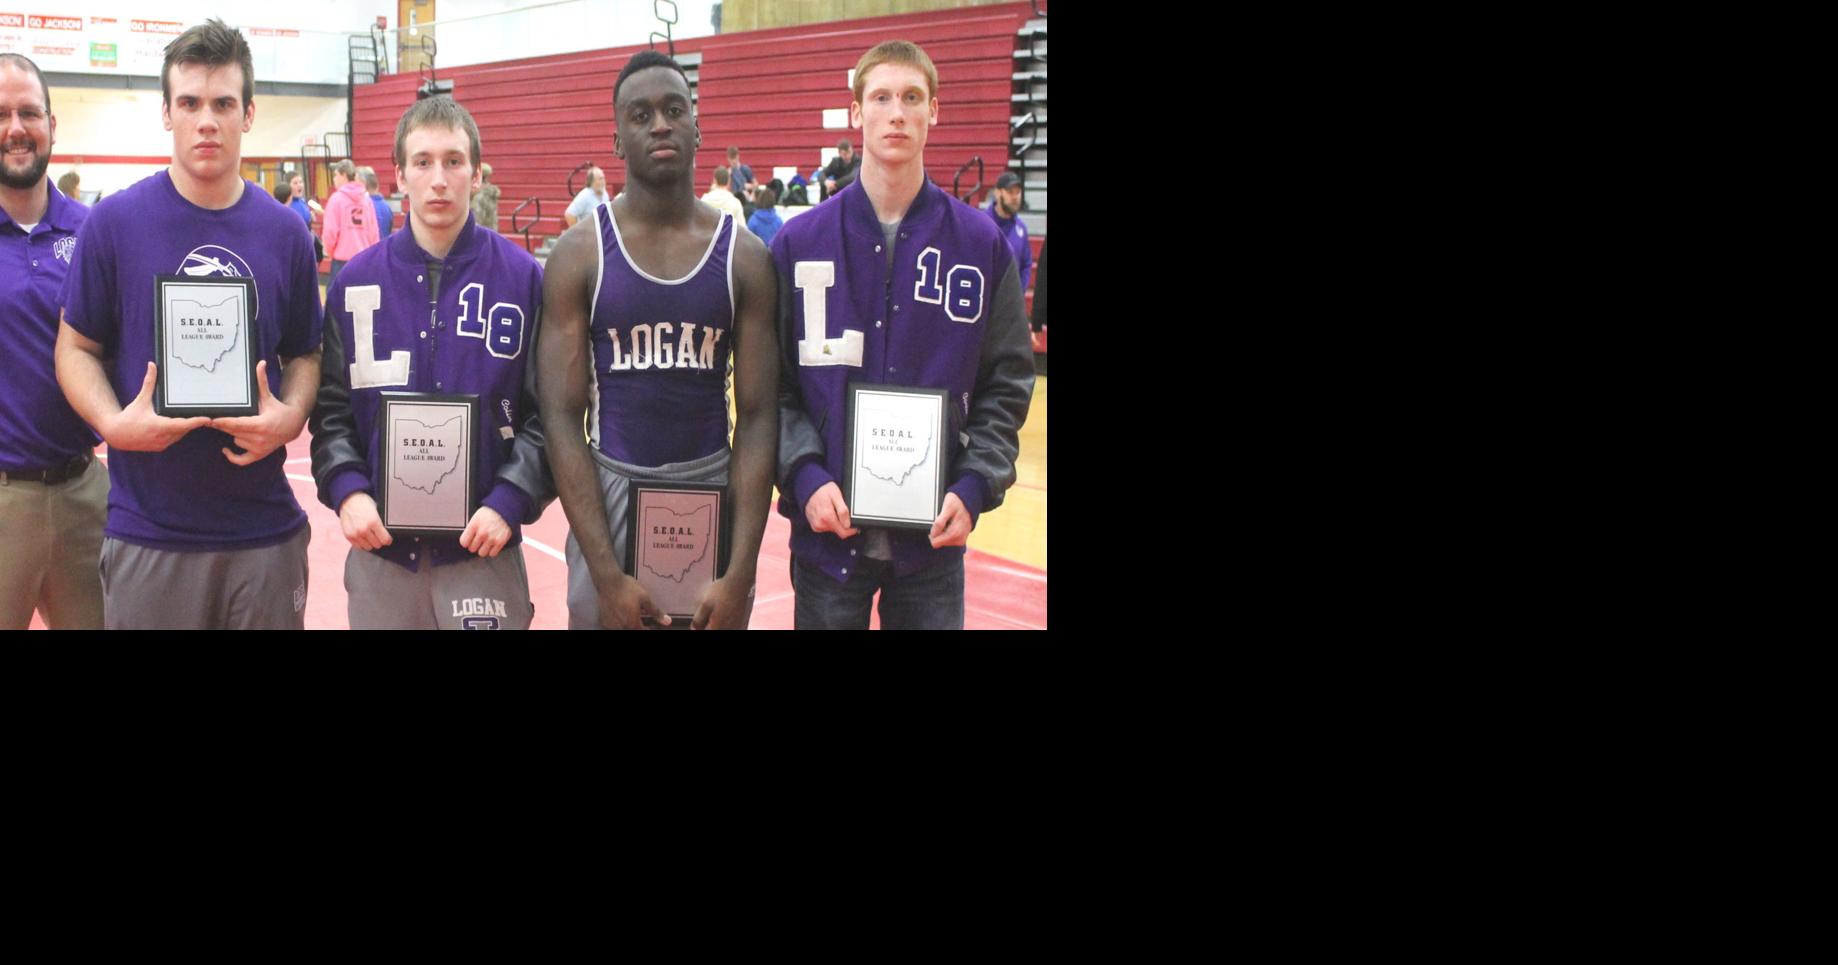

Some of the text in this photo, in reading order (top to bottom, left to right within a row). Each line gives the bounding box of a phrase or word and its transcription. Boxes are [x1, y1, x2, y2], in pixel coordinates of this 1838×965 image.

[30, 18, 42, 28] GO
[130, 22, 144, 32] GO
[794, 260, 865, 368] L
[914, 246, 985, 324] 18
[344, 284, 411, 390] L
[456, 282, 525, 360] 18
[607, 321, 725, 371] LOGAN
[451, 597, 508, 618] LOGAN
